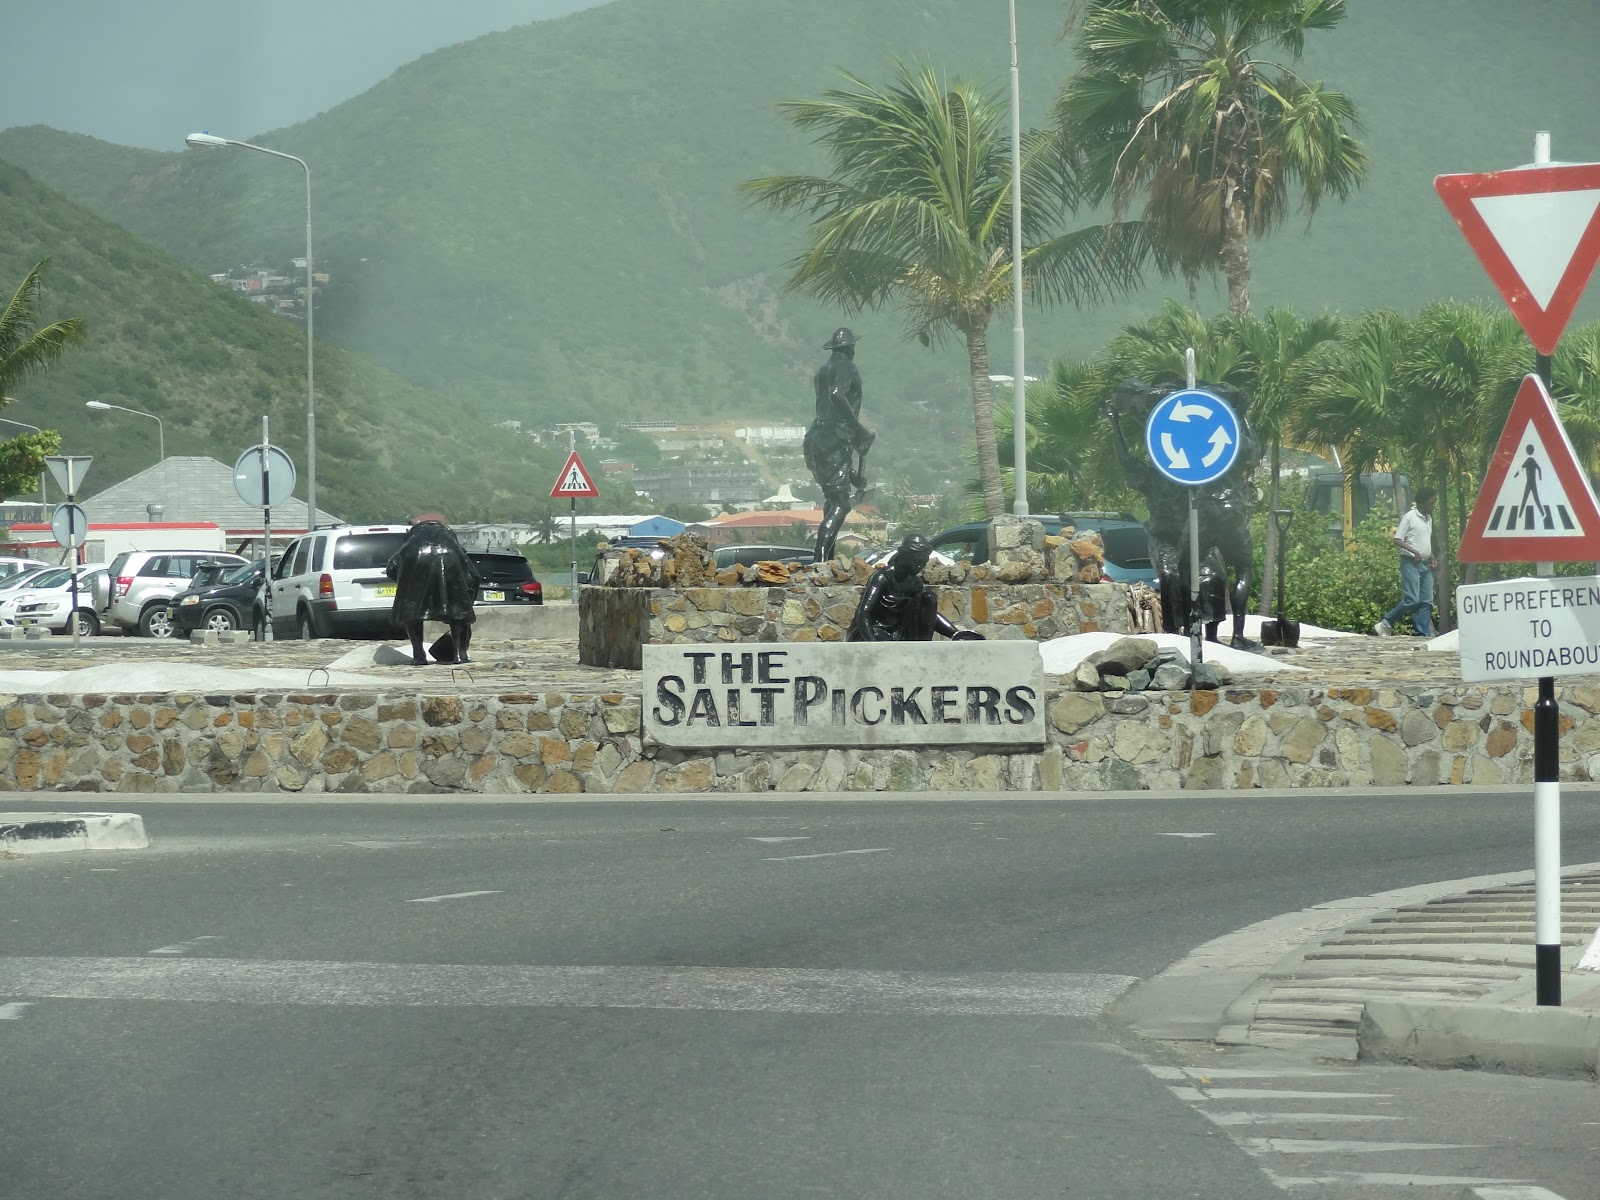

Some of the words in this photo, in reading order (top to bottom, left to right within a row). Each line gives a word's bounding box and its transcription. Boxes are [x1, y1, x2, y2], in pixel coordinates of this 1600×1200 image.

[1463, 593, 1499, 614] GIVE
[1504, 587, 1600, 611] PREFEREN
[1530, 619, 1552, 638] TO
[683, 651, 790, 684] THE
[1485, 645, 1600, 671] ROUNDABOU
[652, 675, 785, 727] SALT
[794, 675, 1036, 726] PICKERS
